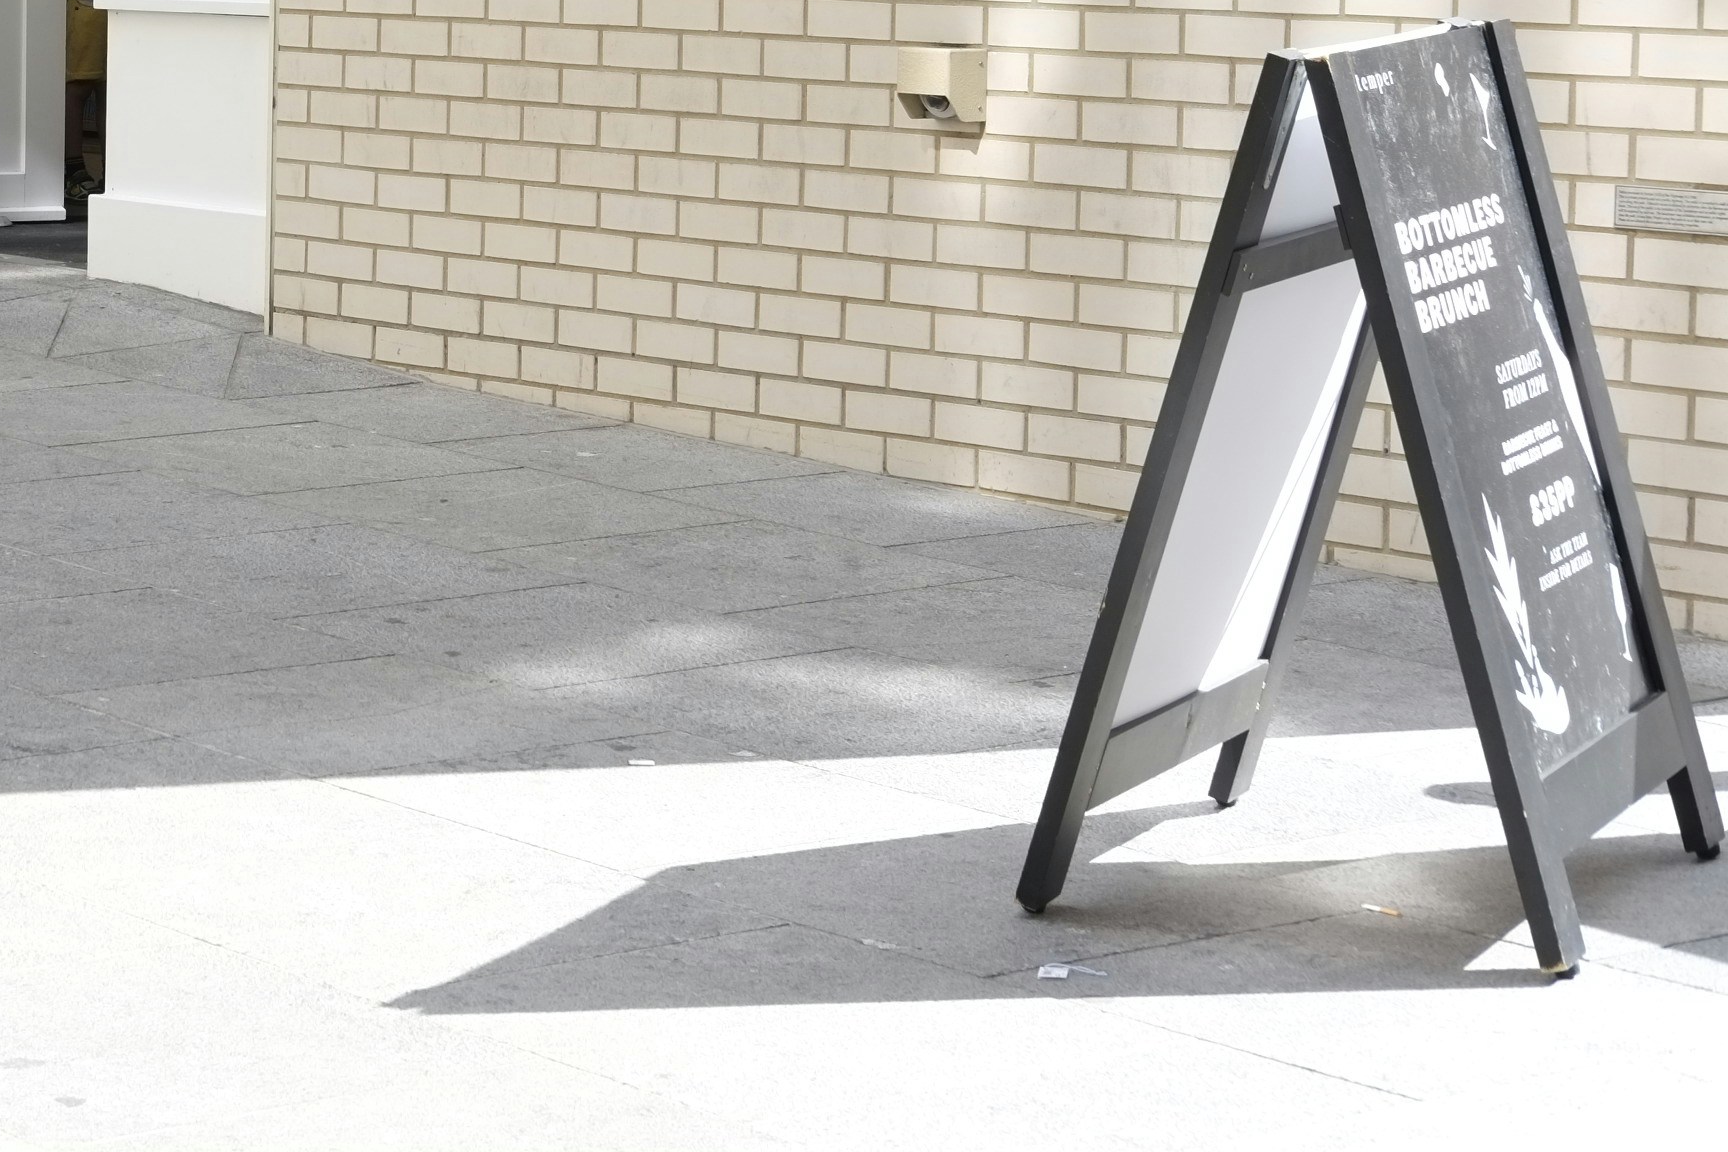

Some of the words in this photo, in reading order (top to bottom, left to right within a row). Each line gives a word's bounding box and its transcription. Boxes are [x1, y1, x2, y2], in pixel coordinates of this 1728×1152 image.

[1354, 70, 1395, 95] temper
[1394, 193, 1505, 255] BOTTOMLESS
[1404, 236, 1498, 295] BARBECUE
[1414, 279, 1491, 334] BRUNCH
[1495, 348, 1543, 385] SATURDAYS
[1502, 380, 1530, 410] FROM
[1525, 372, 1549, 399] 12PM
[1529, 475, 1575, 527] £35PP
[1549, 546, 1564, 565] ASK
[1560, 540, 1575, 558] THE
[1571, 531, 1589, 552] TEAM
[1538, 568, 1561, 592] INSIDE
[1558, 562, 1573, 580] FOR
[1570, 549, 1594, 574] DETAILS
